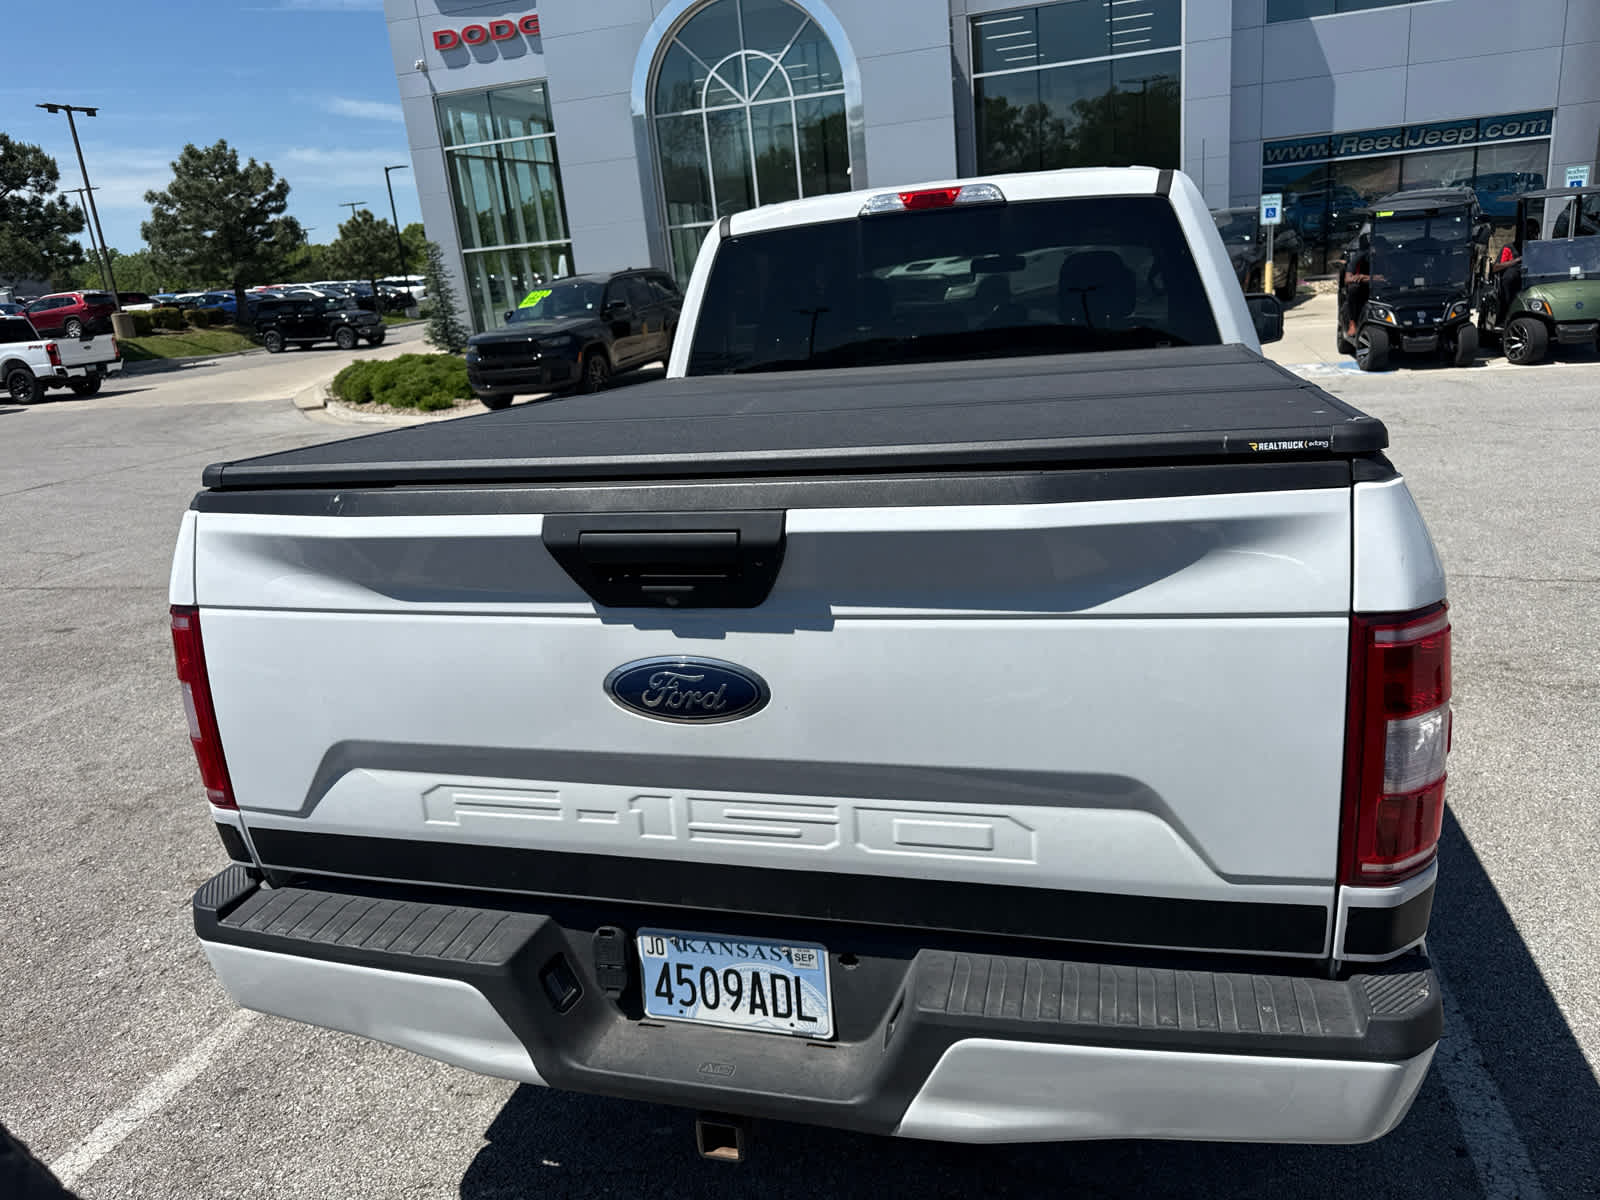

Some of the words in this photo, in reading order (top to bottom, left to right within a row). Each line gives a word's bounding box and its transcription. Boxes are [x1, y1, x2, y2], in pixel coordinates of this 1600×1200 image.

[1265, 118, 1549, 162] www.ReedJeep.com
[1258, 440, 1304, 451] REALTRUCK
[641, 671, 728, 710] Ford
[421, 784, 1039, 864] F-150
[682, 938, 783, 961] KANSAS
[794, 952, 815, 962] SEP
[655, 962, 818, 1023] 4509ADL
